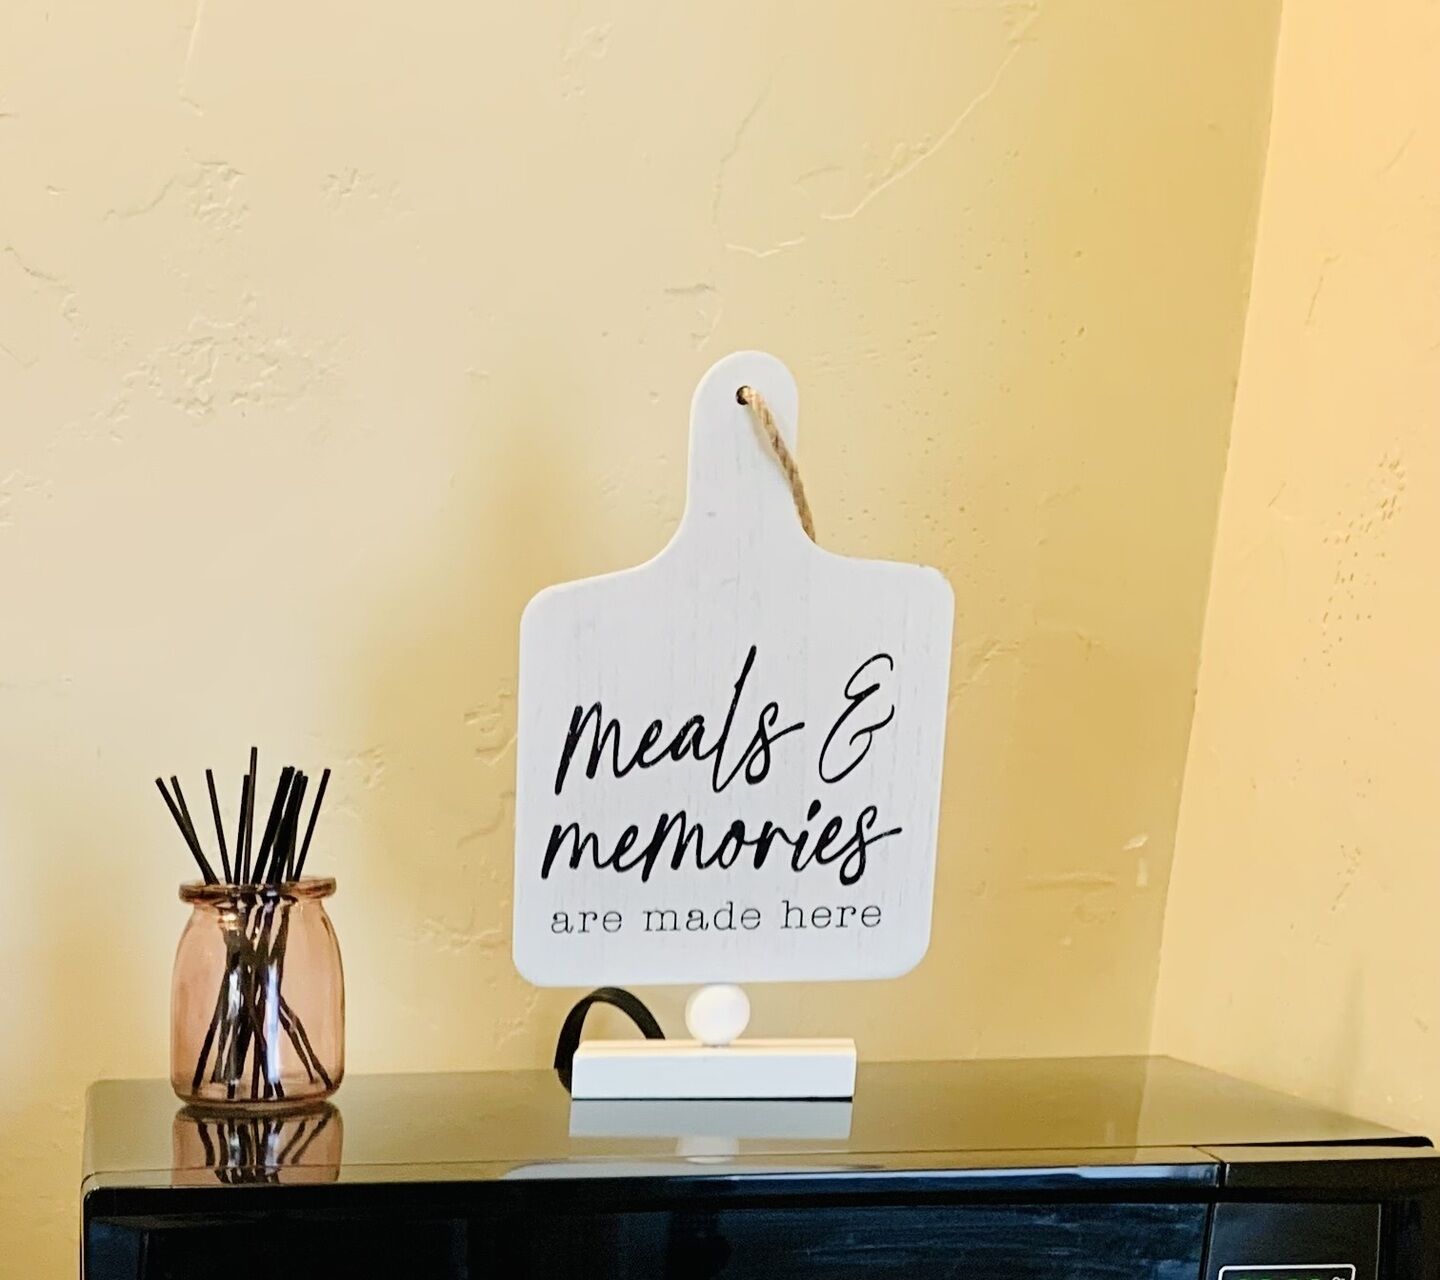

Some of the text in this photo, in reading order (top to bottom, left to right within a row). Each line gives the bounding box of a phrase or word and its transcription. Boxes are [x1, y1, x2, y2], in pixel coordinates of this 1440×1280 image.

[555, 645, 895, 795] meals &
[541, 799, 902, 885] memories
[550, 900, 882, 934] are made here
